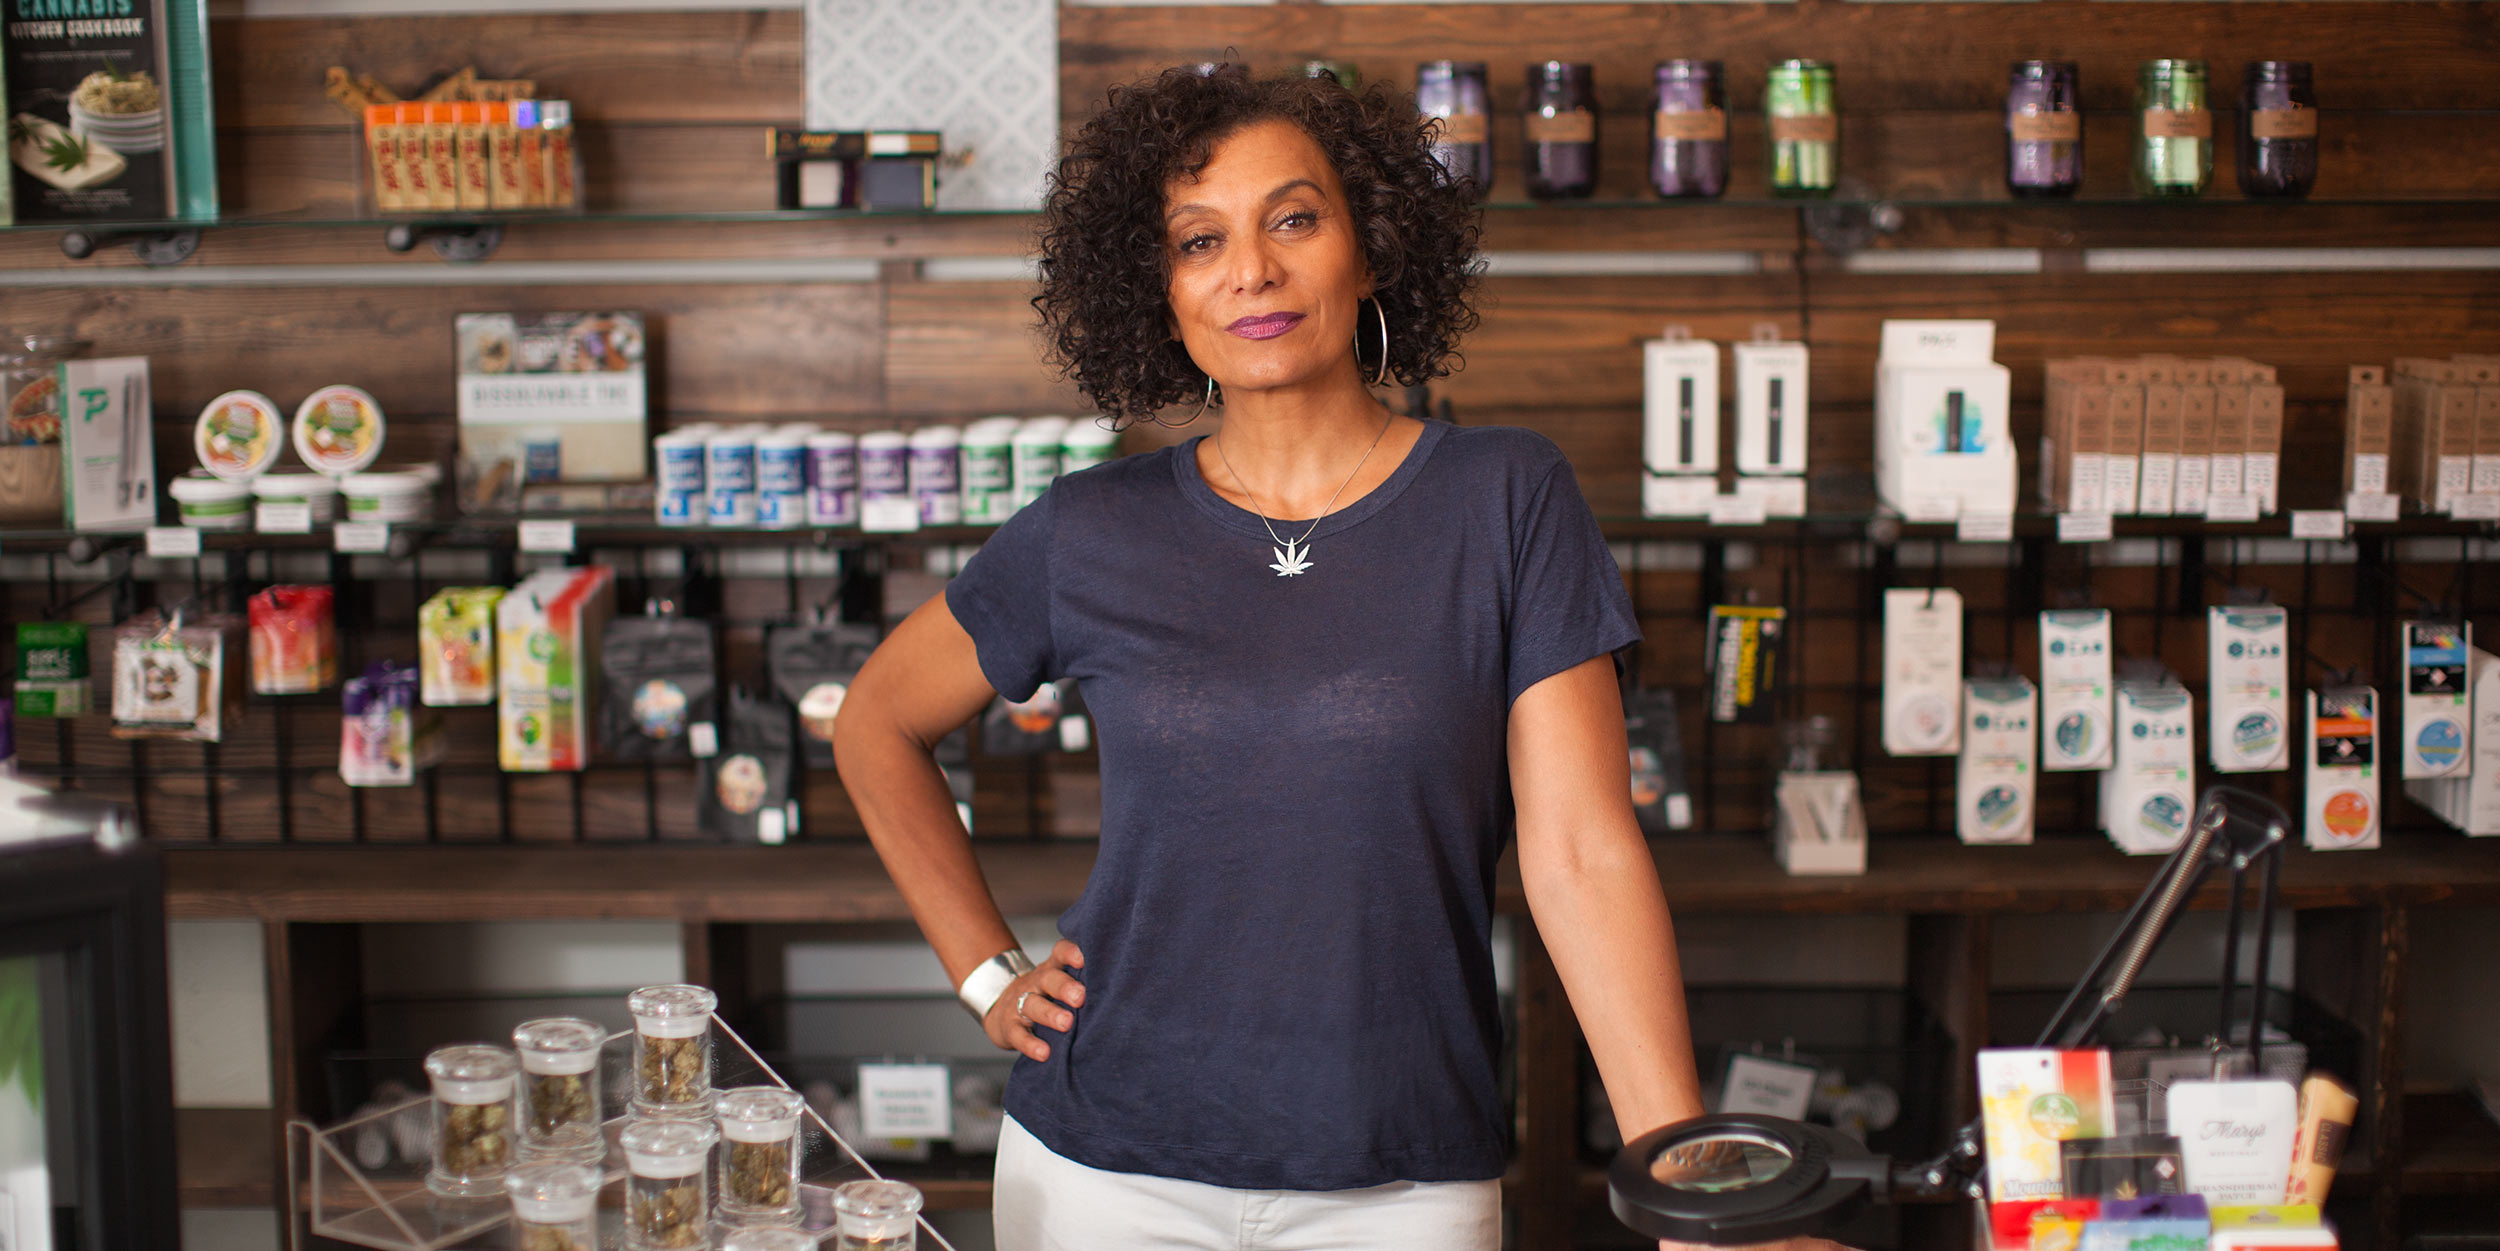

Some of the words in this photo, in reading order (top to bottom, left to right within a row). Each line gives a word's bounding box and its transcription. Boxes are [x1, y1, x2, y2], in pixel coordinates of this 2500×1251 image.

[17, 0, 134, 19] CANNABIS
[66, 18, 144, 38] COOKBOOK
[2199, 1119, 2267, 1147] Mary's
[2315, 1122, 2335, 1163] CLASSIC
[2003, 1178, 2063, 1198] Mountai
[2193, 1182, 2280, 1194] TRANSDERMAL
[2217, 1192, 2258, 1201] PATCH
